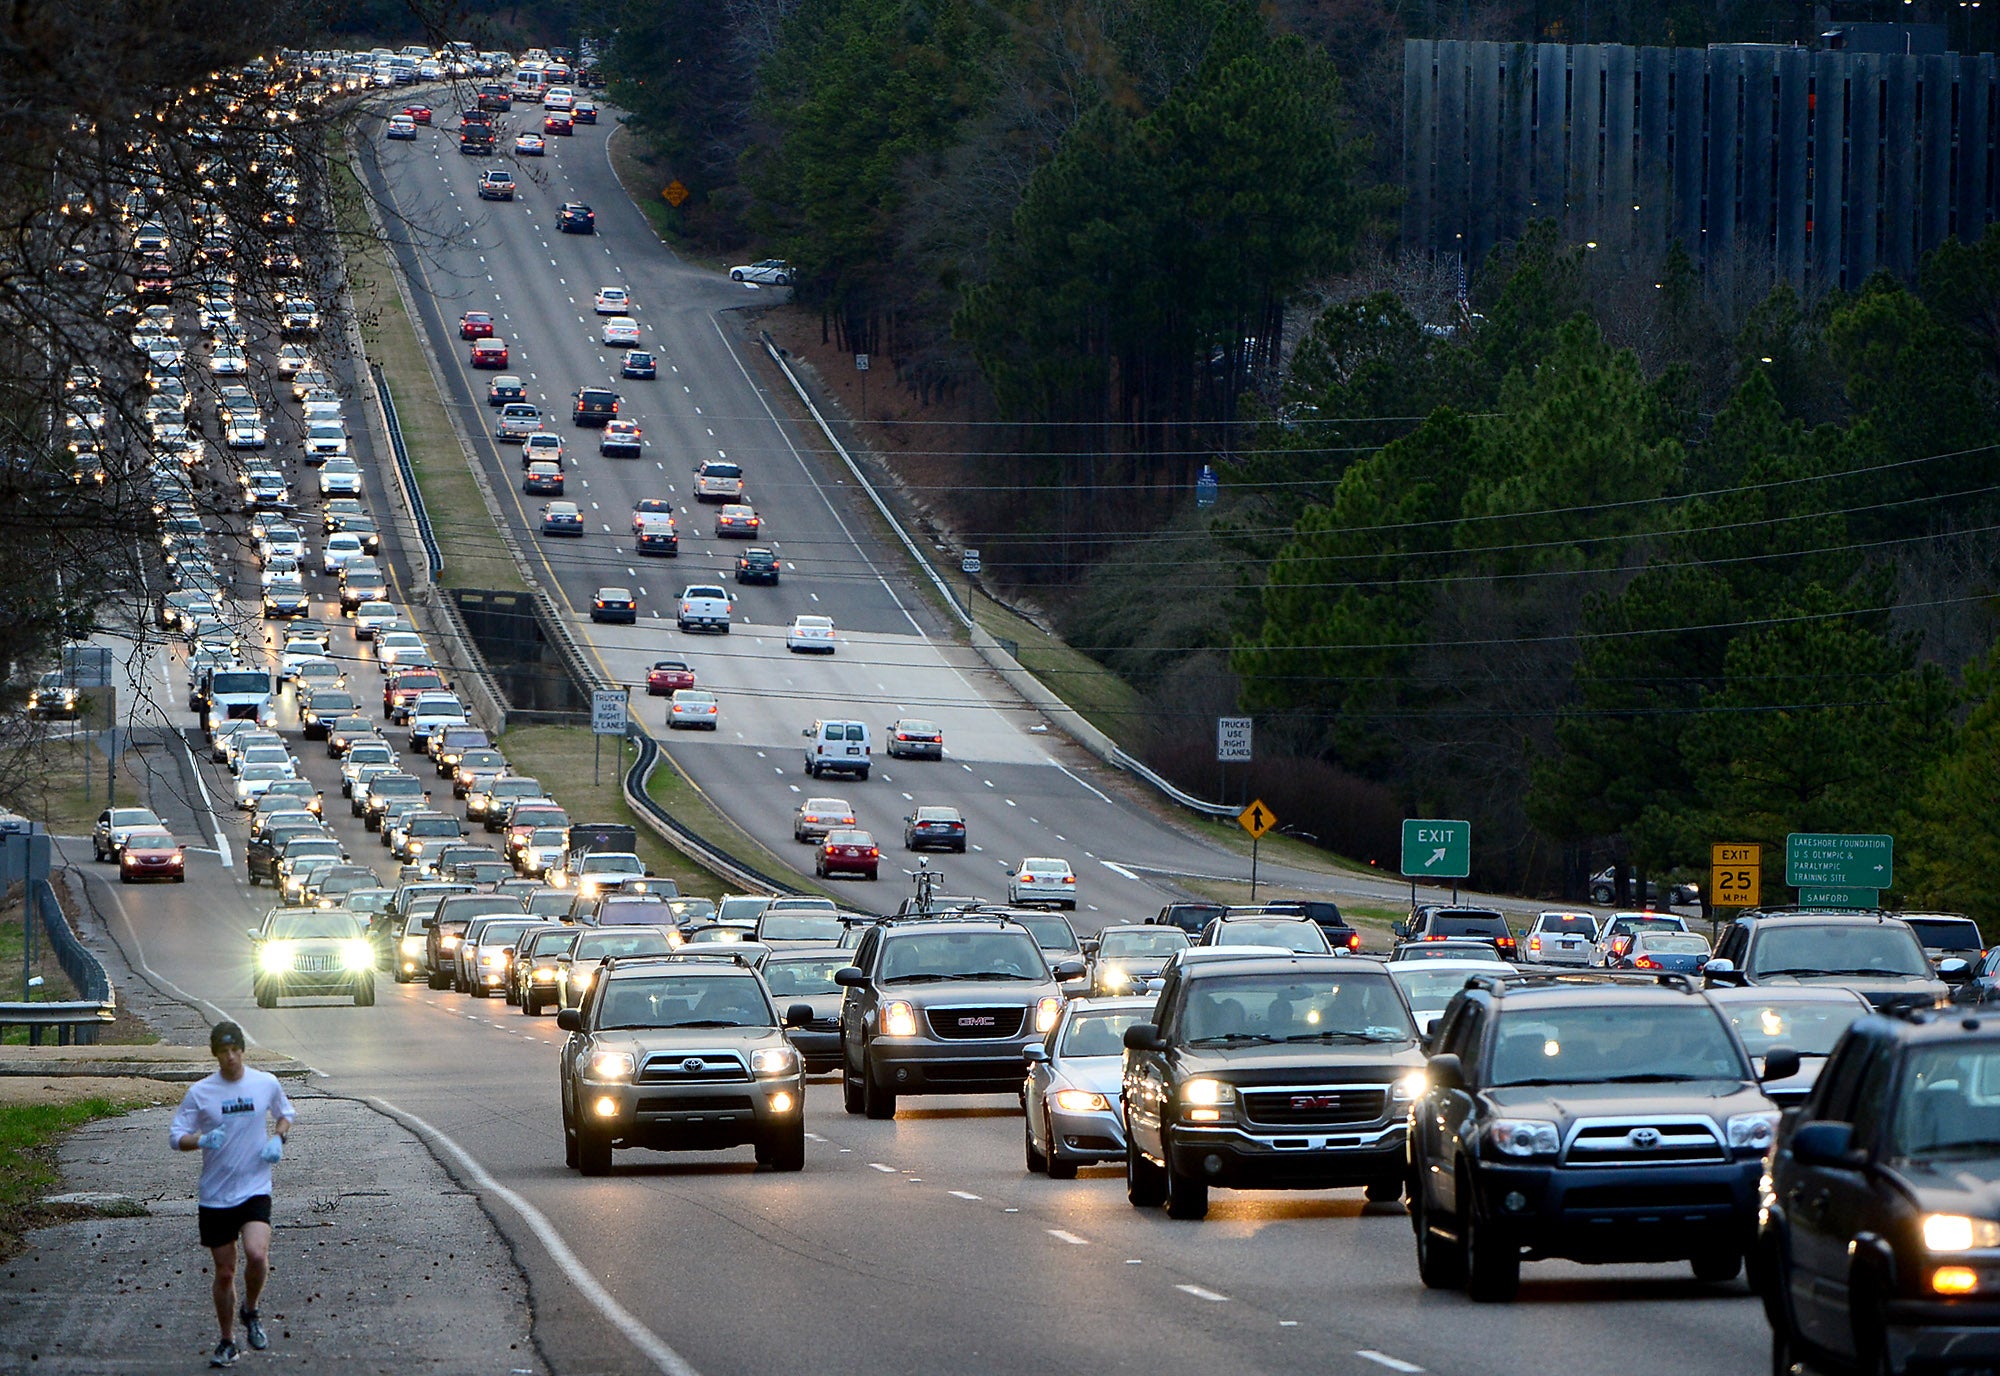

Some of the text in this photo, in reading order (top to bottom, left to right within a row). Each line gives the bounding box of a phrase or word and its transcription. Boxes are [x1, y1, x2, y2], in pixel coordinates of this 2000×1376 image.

[595, 694, 625, 702] TRUCKS
[601, 703, 617, 711] USE
[598, 712, 620, 720] RIGHT
[593, 721, 625, 729] 2 LANES
[1221, 720, 1250, 729] TRUCKS
[1227, 730, 1243, 738] USE
[1223, 740, 1246, 748] RIGHT
[1219, 748, 1250, 757] 2 LANES
[1418, 829, 1454, 843] EXIT
[1794, 838, 1886, 849] LAKESHORE FOUNDATION
[1722, 850, 1750, 860] EXIT
[1812, 850, 1844, 860] OLYMPIC
[1846, 851, 1854, 860] &
[1794, 861, 1841, 871] PARALYMPIC
[1719, 871, 1752, 890] 25
[1794, 872, 1847, 883] TRAINING SITE
[1807, 894, 1849, 902] SAMFORD
[958, 1016, 995, 1026] GMC
[1290, 1095, 1341, 1109] GMC
